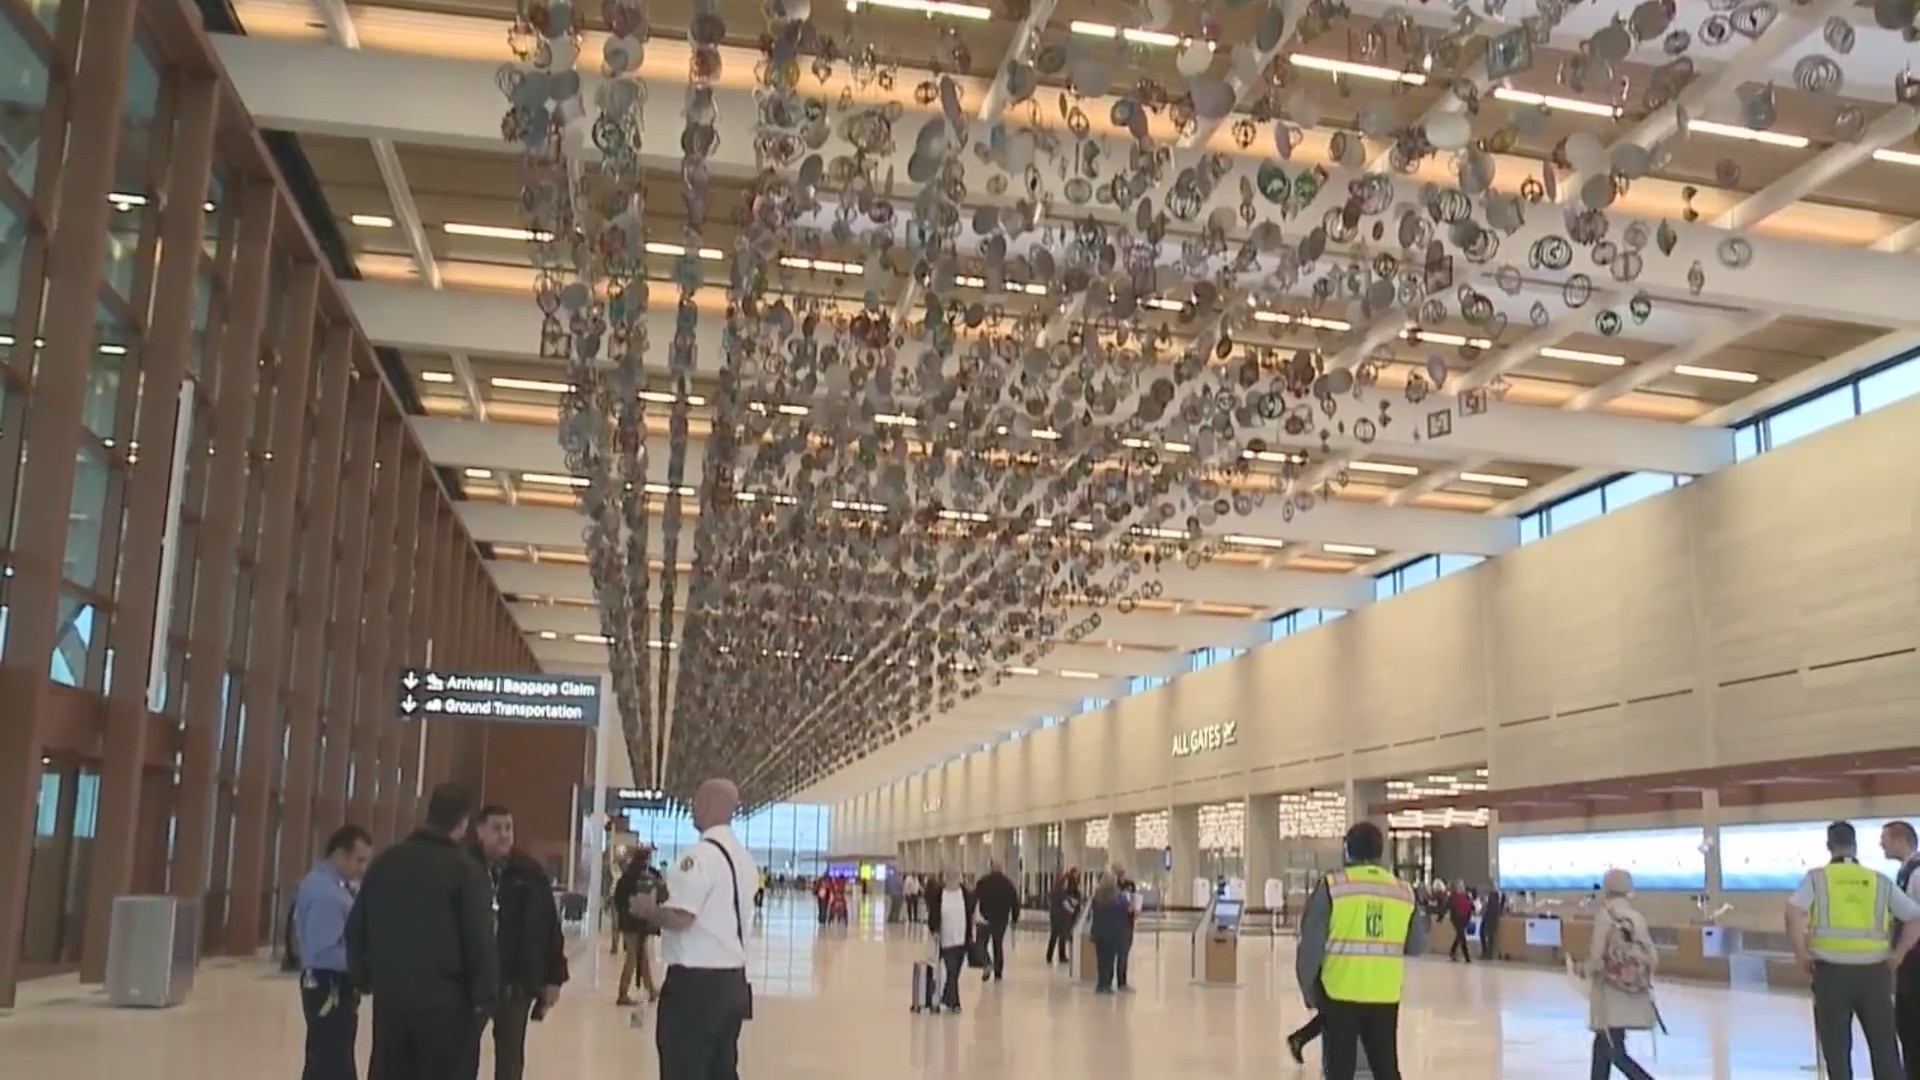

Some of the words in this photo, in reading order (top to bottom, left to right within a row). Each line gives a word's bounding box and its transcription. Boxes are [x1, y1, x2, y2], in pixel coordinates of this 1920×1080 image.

[447, 676, 494, 692] Arrivals
[503, 679, 557, 697] Baggage
[560, 681, 595, 697] Claim
[445, 698, 491, 714] Ground
[494, 701, 582, 719] Transportation
[1172, 734, 1189, 757] ALL
[1191, 723, 1221, 753] GATES
